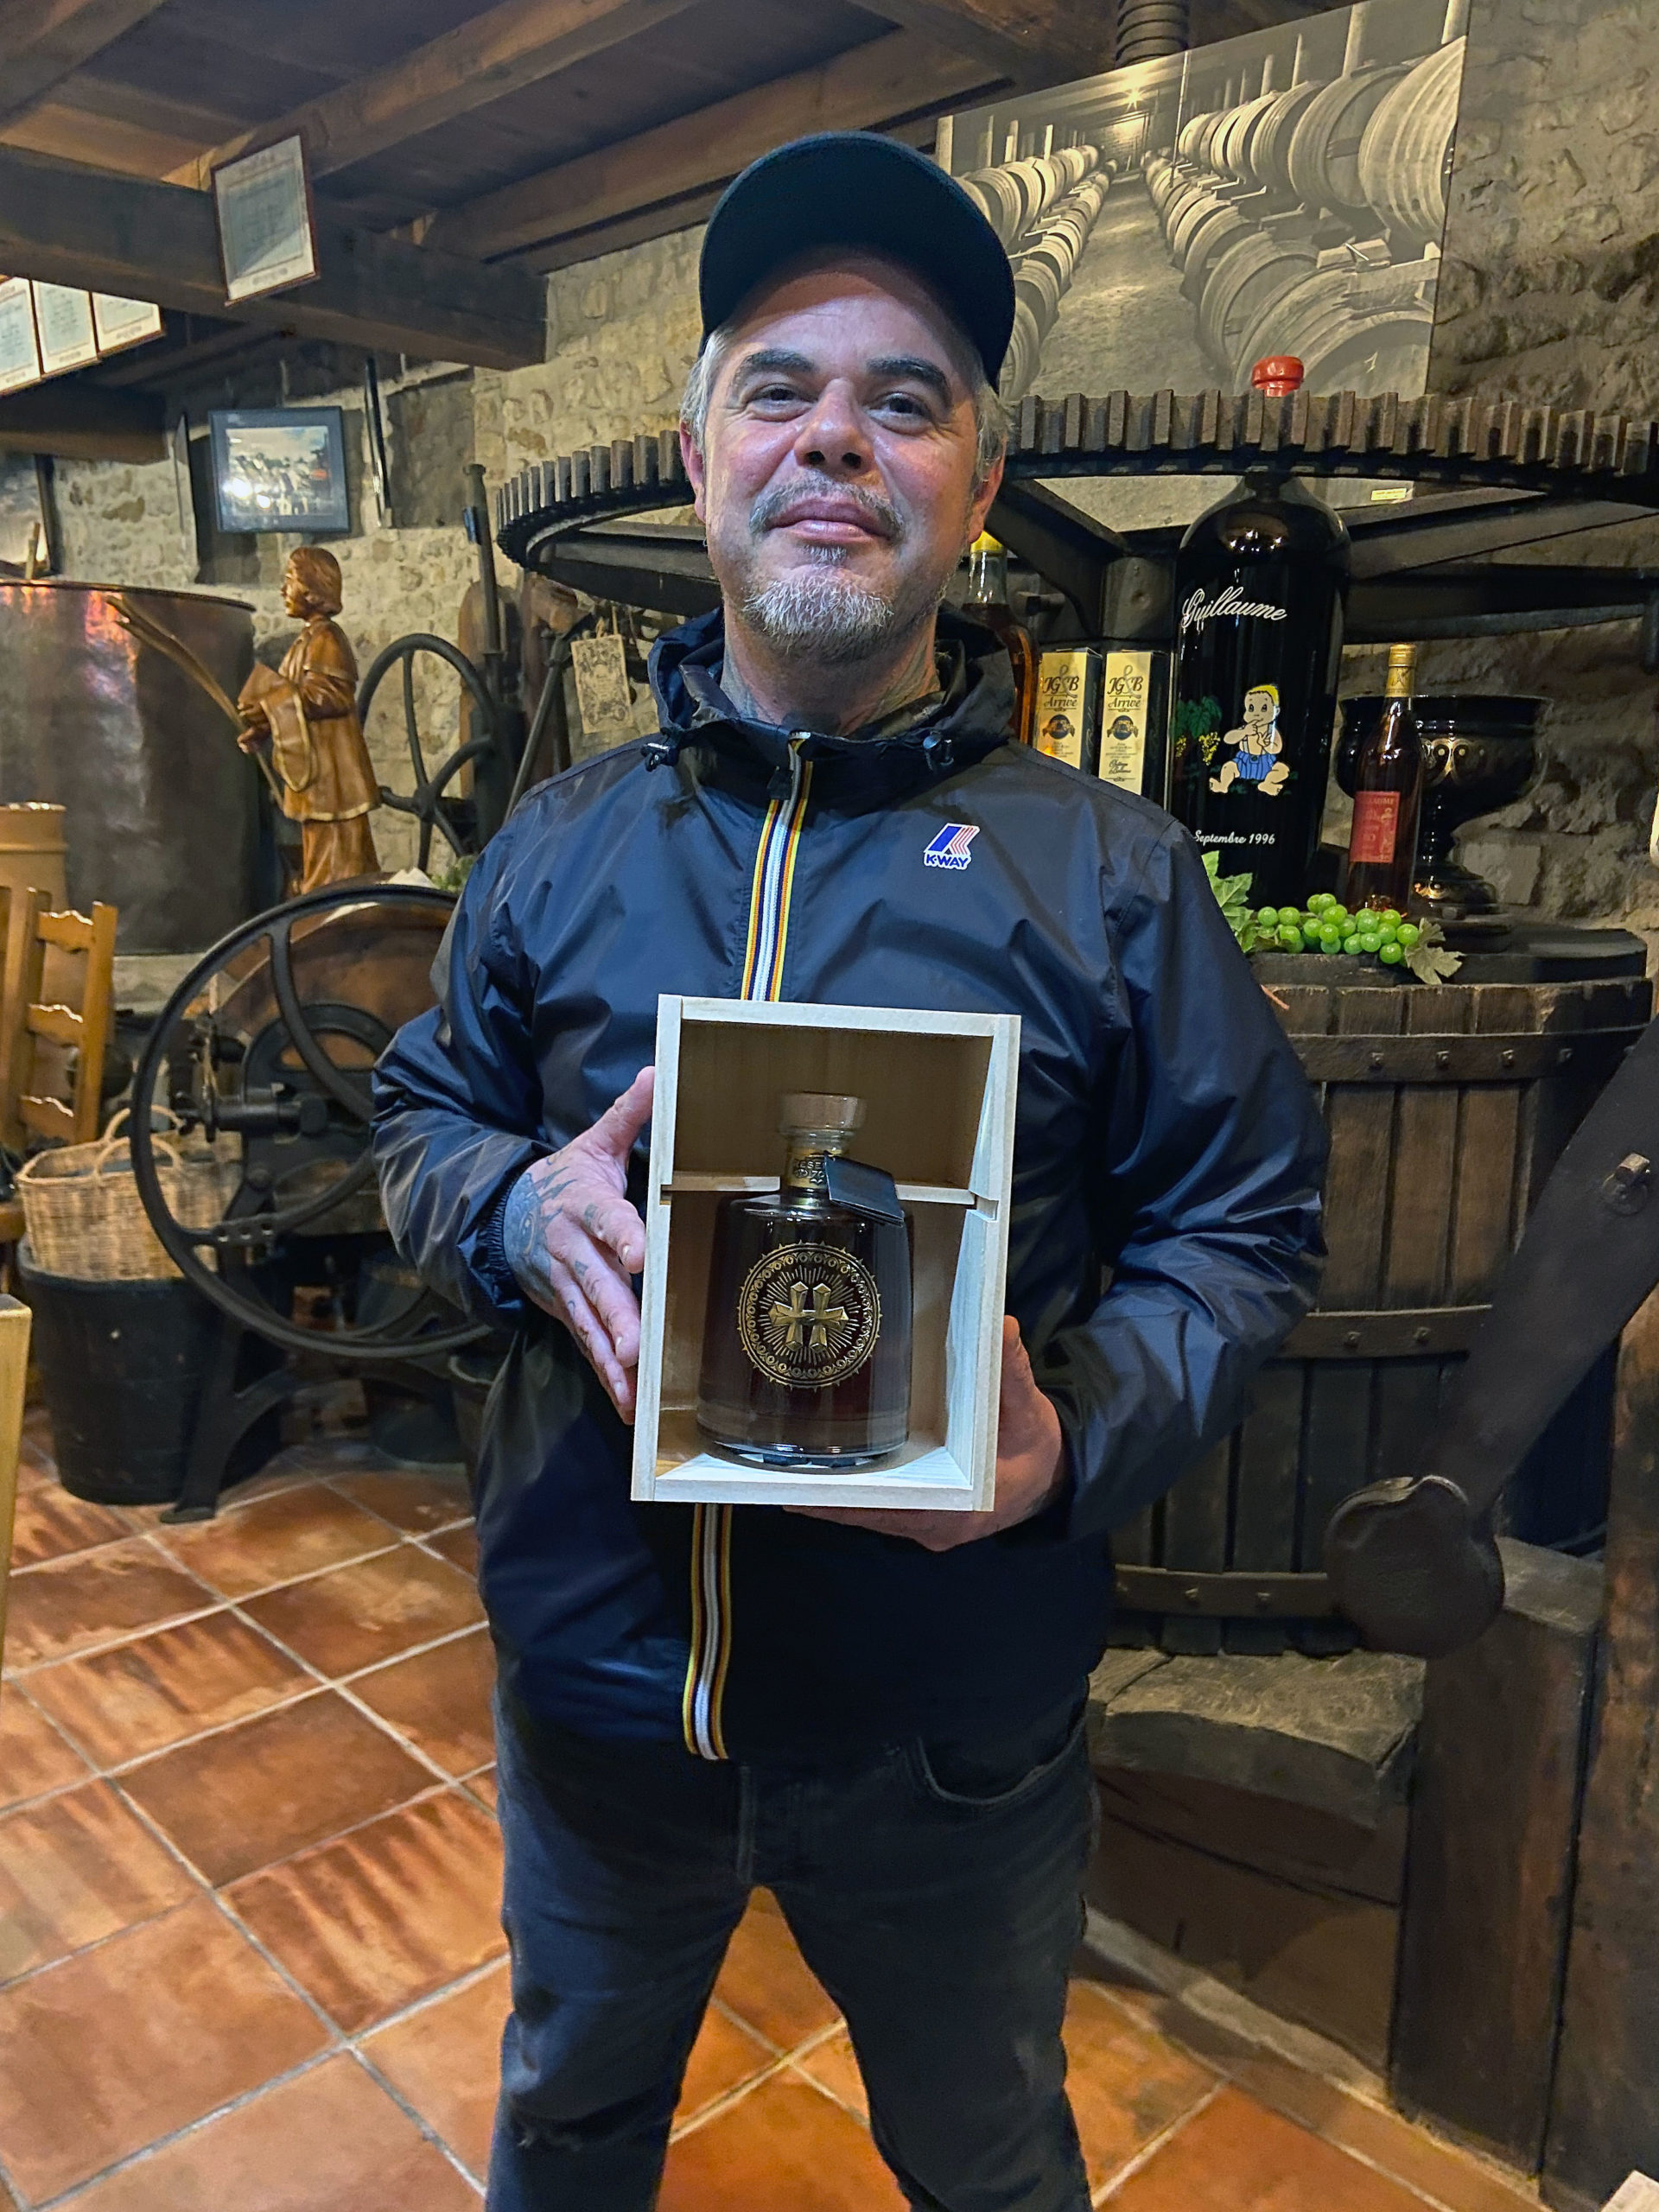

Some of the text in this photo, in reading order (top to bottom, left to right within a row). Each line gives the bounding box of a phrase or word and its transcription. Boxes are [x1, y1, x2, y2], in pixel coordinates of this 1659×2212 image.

[1181, 586, 1287, 628] Guillaume
[1194, 830, 1275, 846] Septembre 1996
[926, 854, 969, 868] K-WAY
